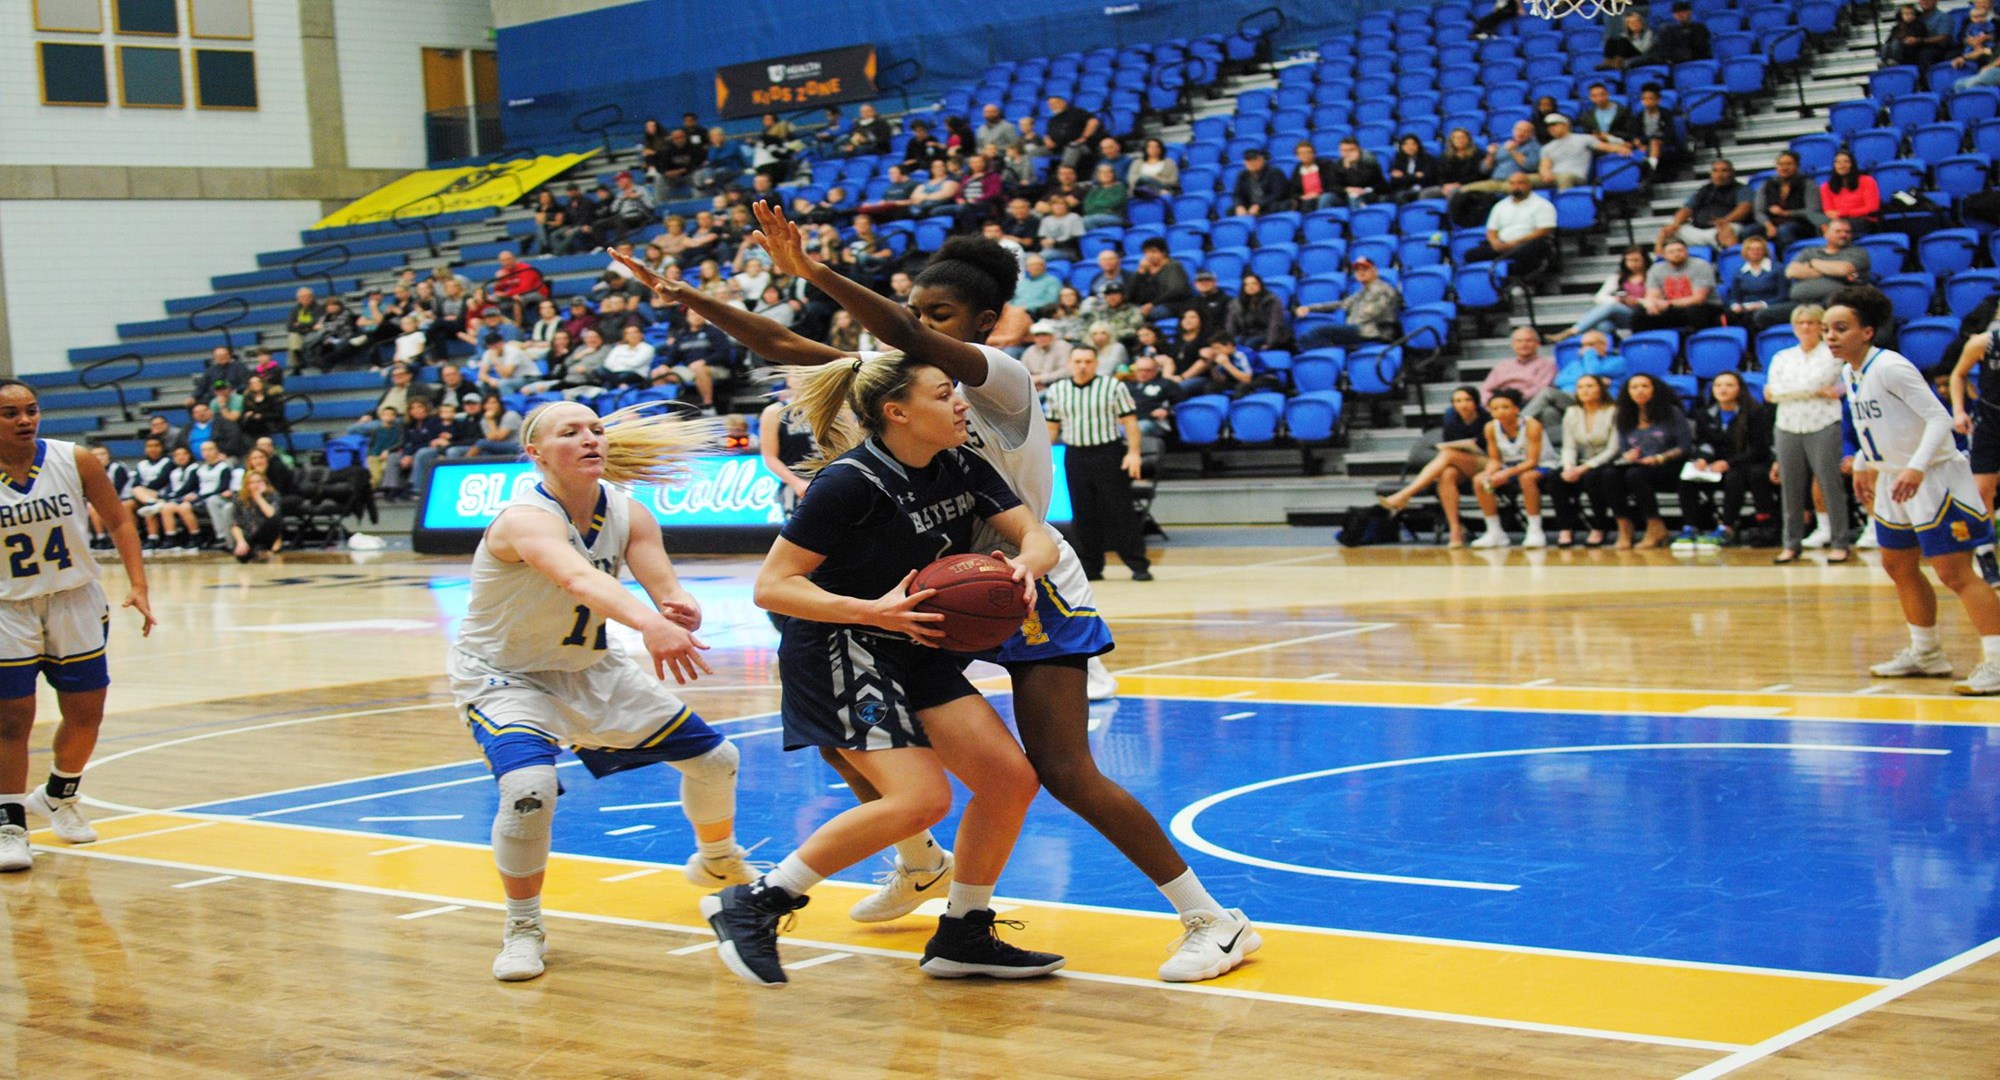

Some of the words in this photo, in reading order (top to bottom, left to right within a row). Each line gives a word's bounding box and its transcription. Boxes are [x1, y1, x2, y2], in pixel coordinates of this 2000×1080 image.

[752, 89, 791, 105] KIDS
[796, 78, 841, 102] ZONE
[1854, 400, 1883, 421] INS
[1862, 427, 1884, 462] 1
[0, 493, 74, 528] RUINS
[4, 526, 73, 578] 24
